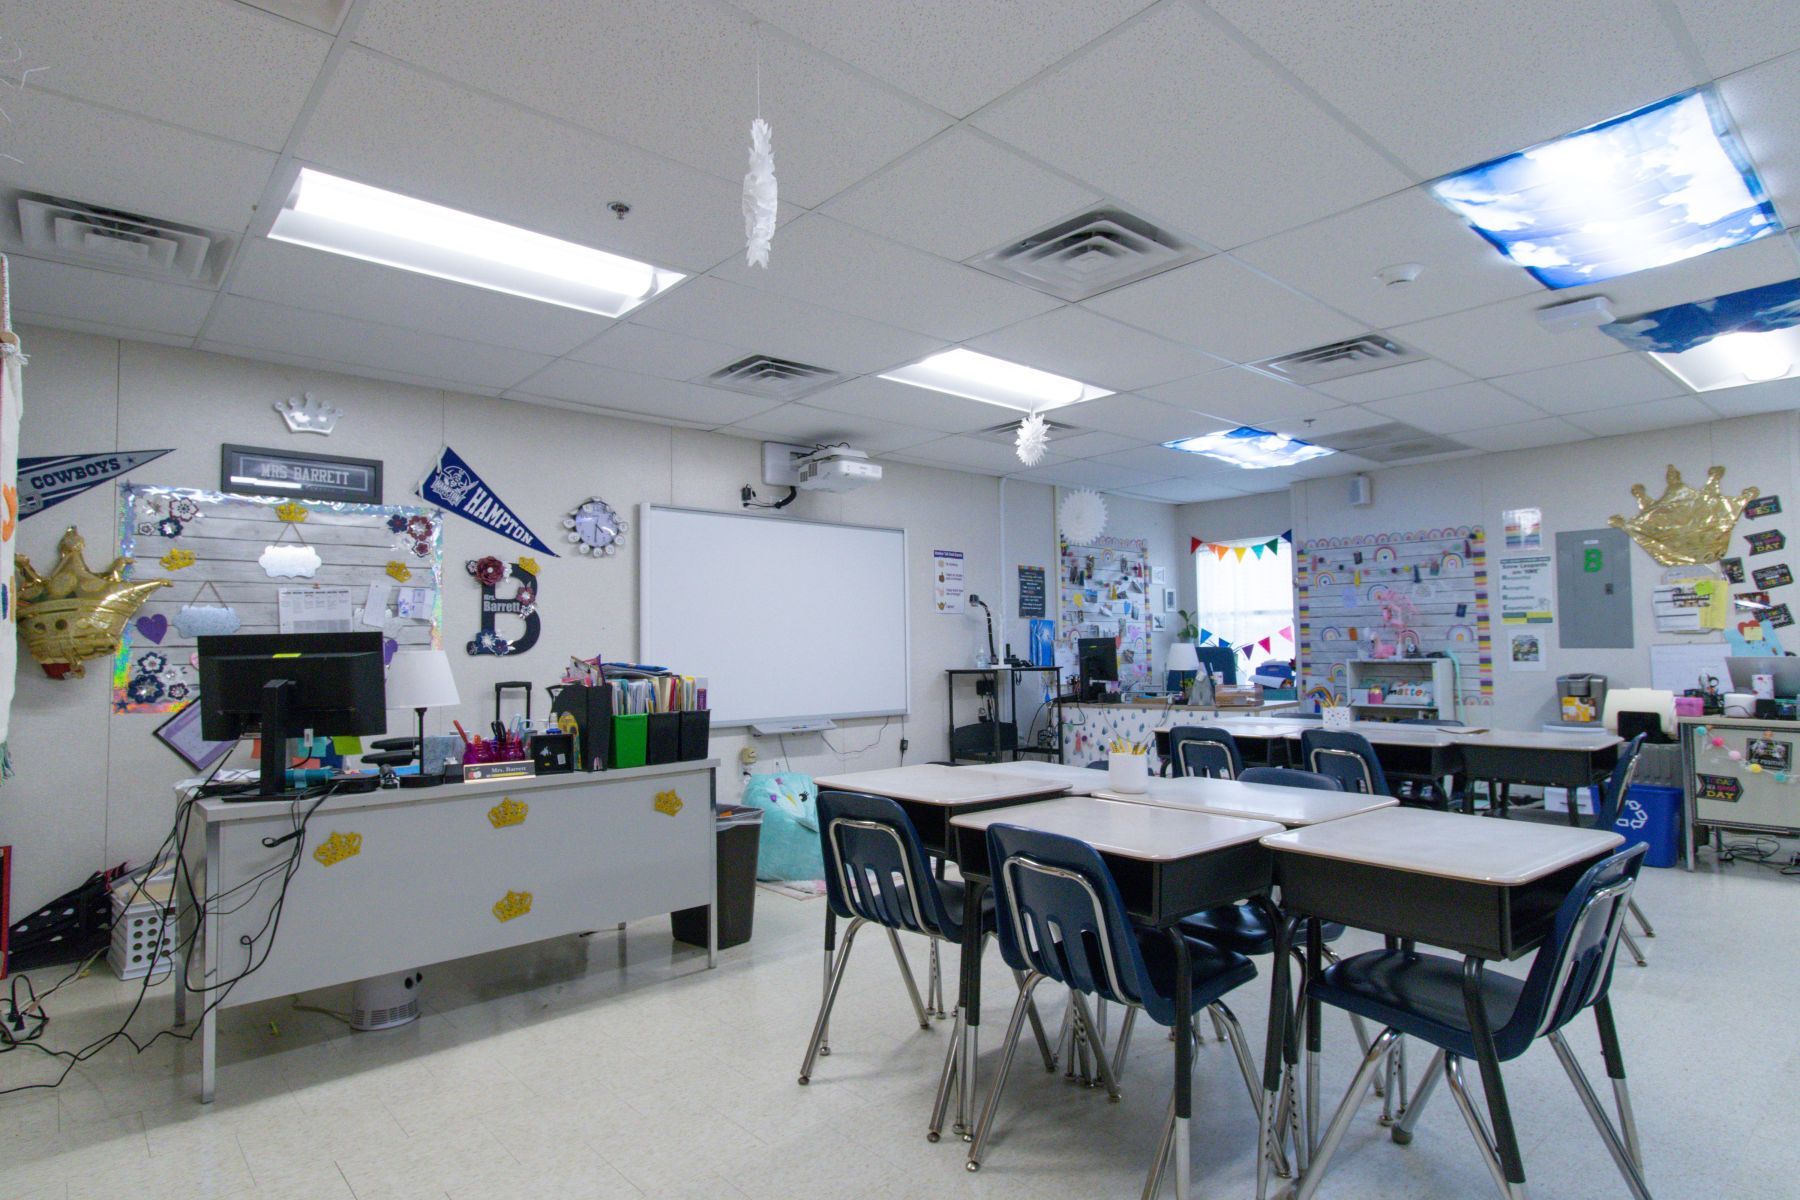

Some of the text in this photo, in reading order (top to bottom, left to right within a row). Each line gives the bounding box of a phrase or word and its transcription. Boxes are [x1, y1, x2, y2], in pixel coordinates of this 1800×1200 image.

[30, 458, 121, 489] COWBOYS
[260, 463, 350, 485] MRS BARRETT
[463, 486, 534, 545] HAMPTON
[1584, 549, 1602, 572] B
[483, 601, 521, 612] Barrett
[1706, 790, 1735, 800] DAY
